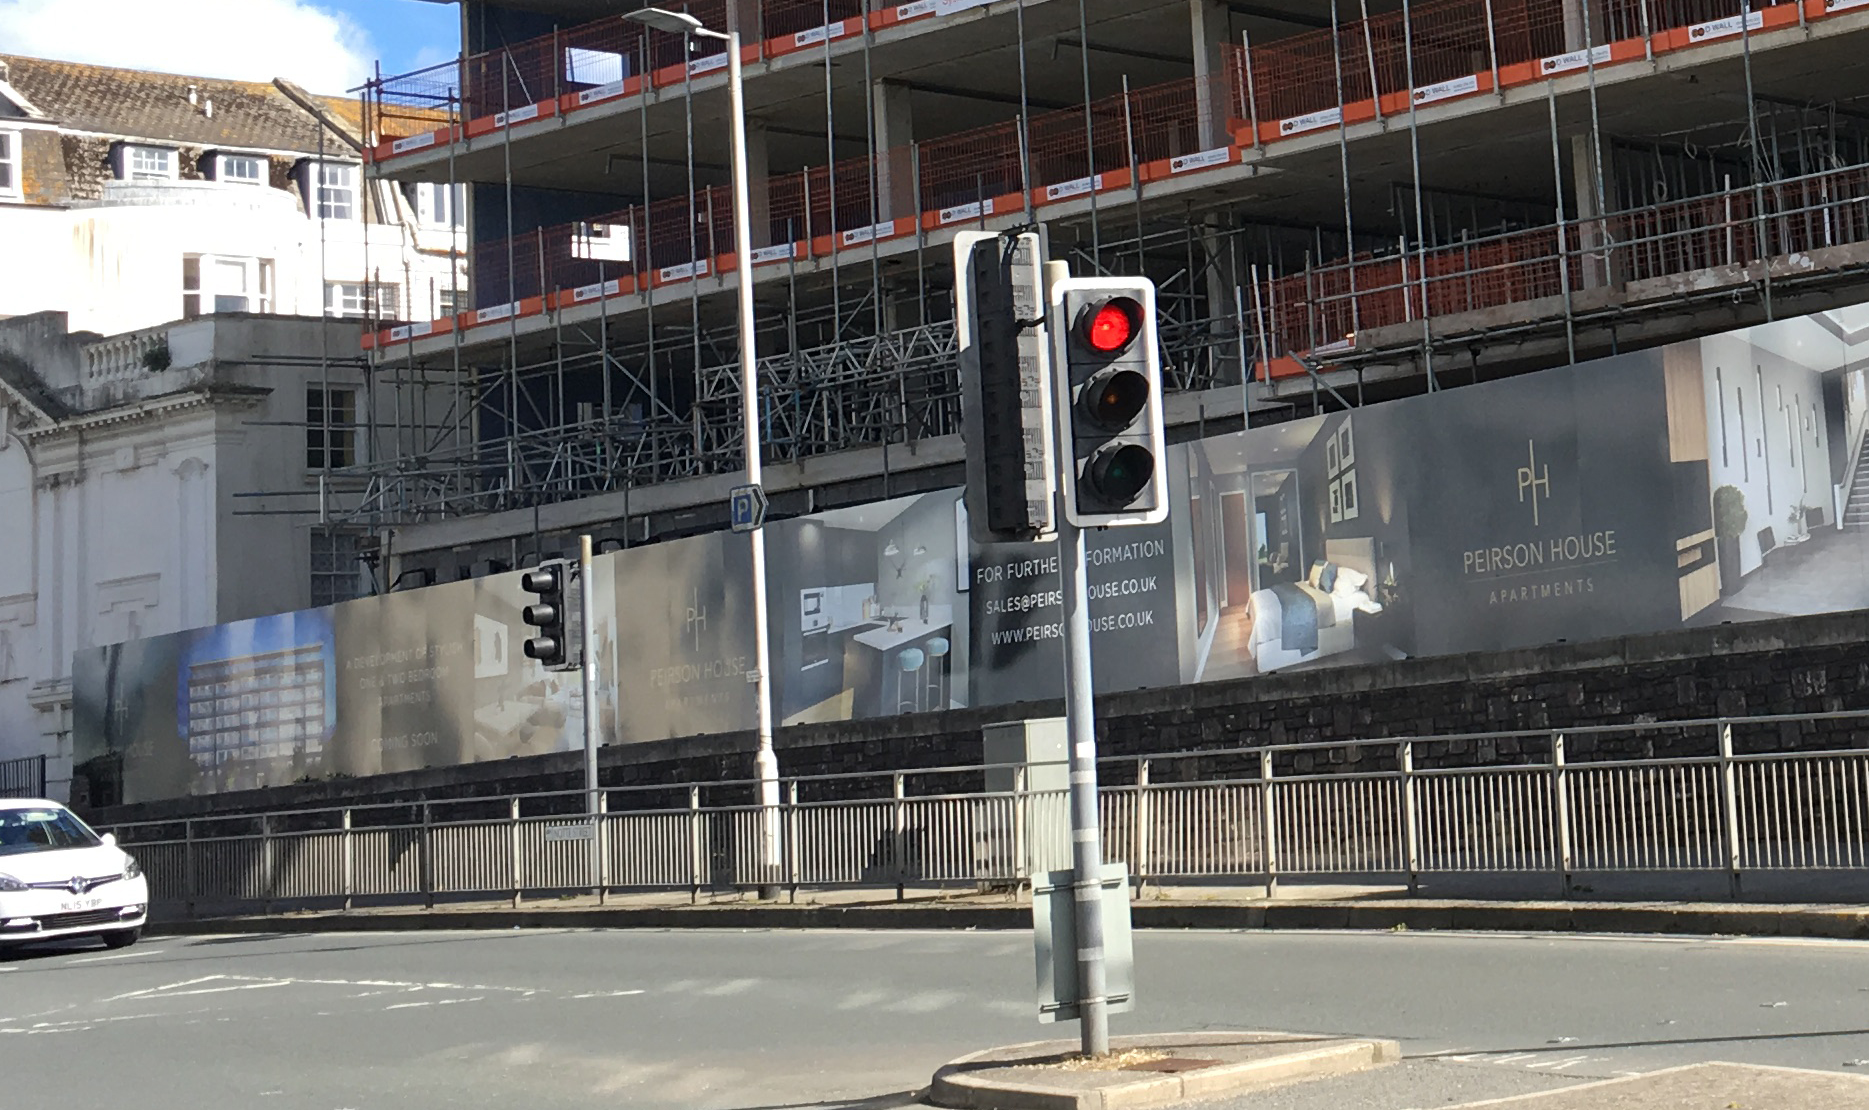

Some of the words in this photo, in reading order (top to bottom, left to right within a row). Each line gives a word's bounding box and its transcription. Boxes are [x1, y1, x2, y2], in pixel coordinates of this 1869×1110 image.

[1712, 20, 1732, 31] WALL
[1563, 54, 1581, 64] WALL
[1518, 439, 1549, 526] PH
[738, 499, 748, 522] P
[976, 566, 1003, 584] FOR
[1007, 556, 1058, 580] FURTHE
[1085, 540, 1164, 567] FORMATION
[1463, 542, 1543, 574] PEIRSON
[1550, 531, 1616, 562] HOUSE
[986, 576, 1158, 615] SALES@PEIRSOUSE.CO.UK
[1490, 578, 1594, 604] APARTMENTS
[991, 610, 1154, 645] WWW.PEIRSOUSE.CO.UK
[704, 657, 745, 679] HOUSE
[411, 732, 438, 747] SOON
